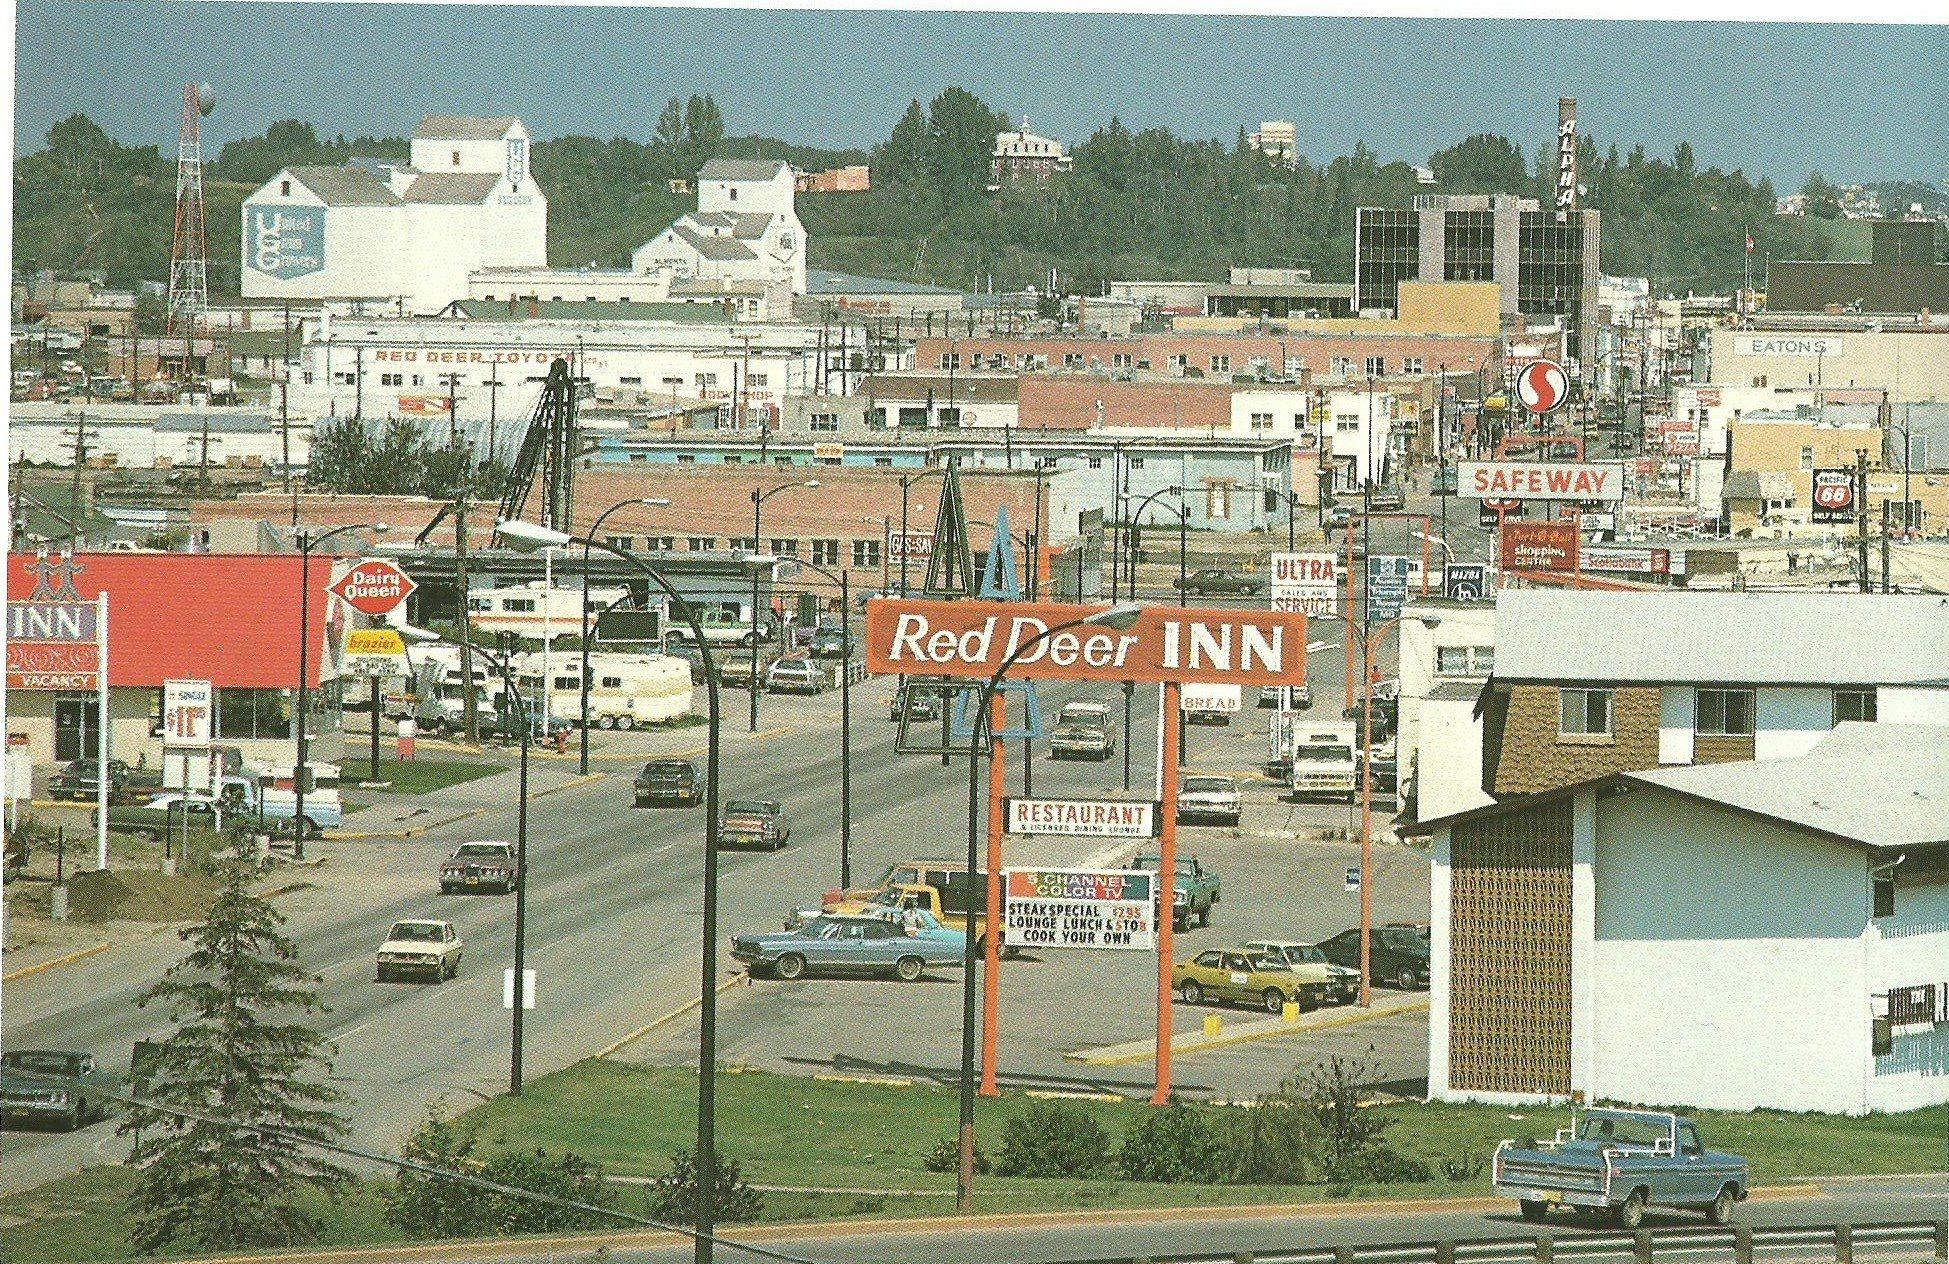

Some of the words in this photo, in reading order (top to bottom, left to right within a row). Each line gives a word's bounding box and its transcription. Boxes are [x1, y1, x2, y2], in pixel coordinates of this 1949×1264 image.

[1556, 120, 1576, 206] ALPHA
[375, 351, 417, 362] RED
[427, 352, 483, 363] DEER
[1474, 468, 1609, 494] SAFEWAY
[1822, 486, 1846, 503] 66
[352, 568, 400, 586] Dairy
[1277, 559, 1335, 581] ULTRA
[344, 584, 401, 601] Queen
[1275, 597, 1333, 616] SERVICE
[13, 606, 81, 639] INN
[889, 613, 998, 663] Red
[1000, 617, 1139, 668] Deer
[1161, 621, 1285, 673] INN
[1184, 697, 1236, 710] BREAD
[1017, 803, 1146, 825] RESTAURANT
[1043, 874, 1133, 888] CHANNEL
[1036, 885, 1098, 899] COLOR
[1105, 888, 1124, 898] TV
[1008, 903, 1047, 916] STEAK
[1049, 904, 1101, 918] SPECIAL
[1009, 917, 1057, 930] LOUNGE
[1063, 918, 1102, 931] LUNCH
[1023, 929, 1056, 943] COOK
[1062, 931, 1096, 944] YOUR
[1103, 931, 1132, 945] OWN
